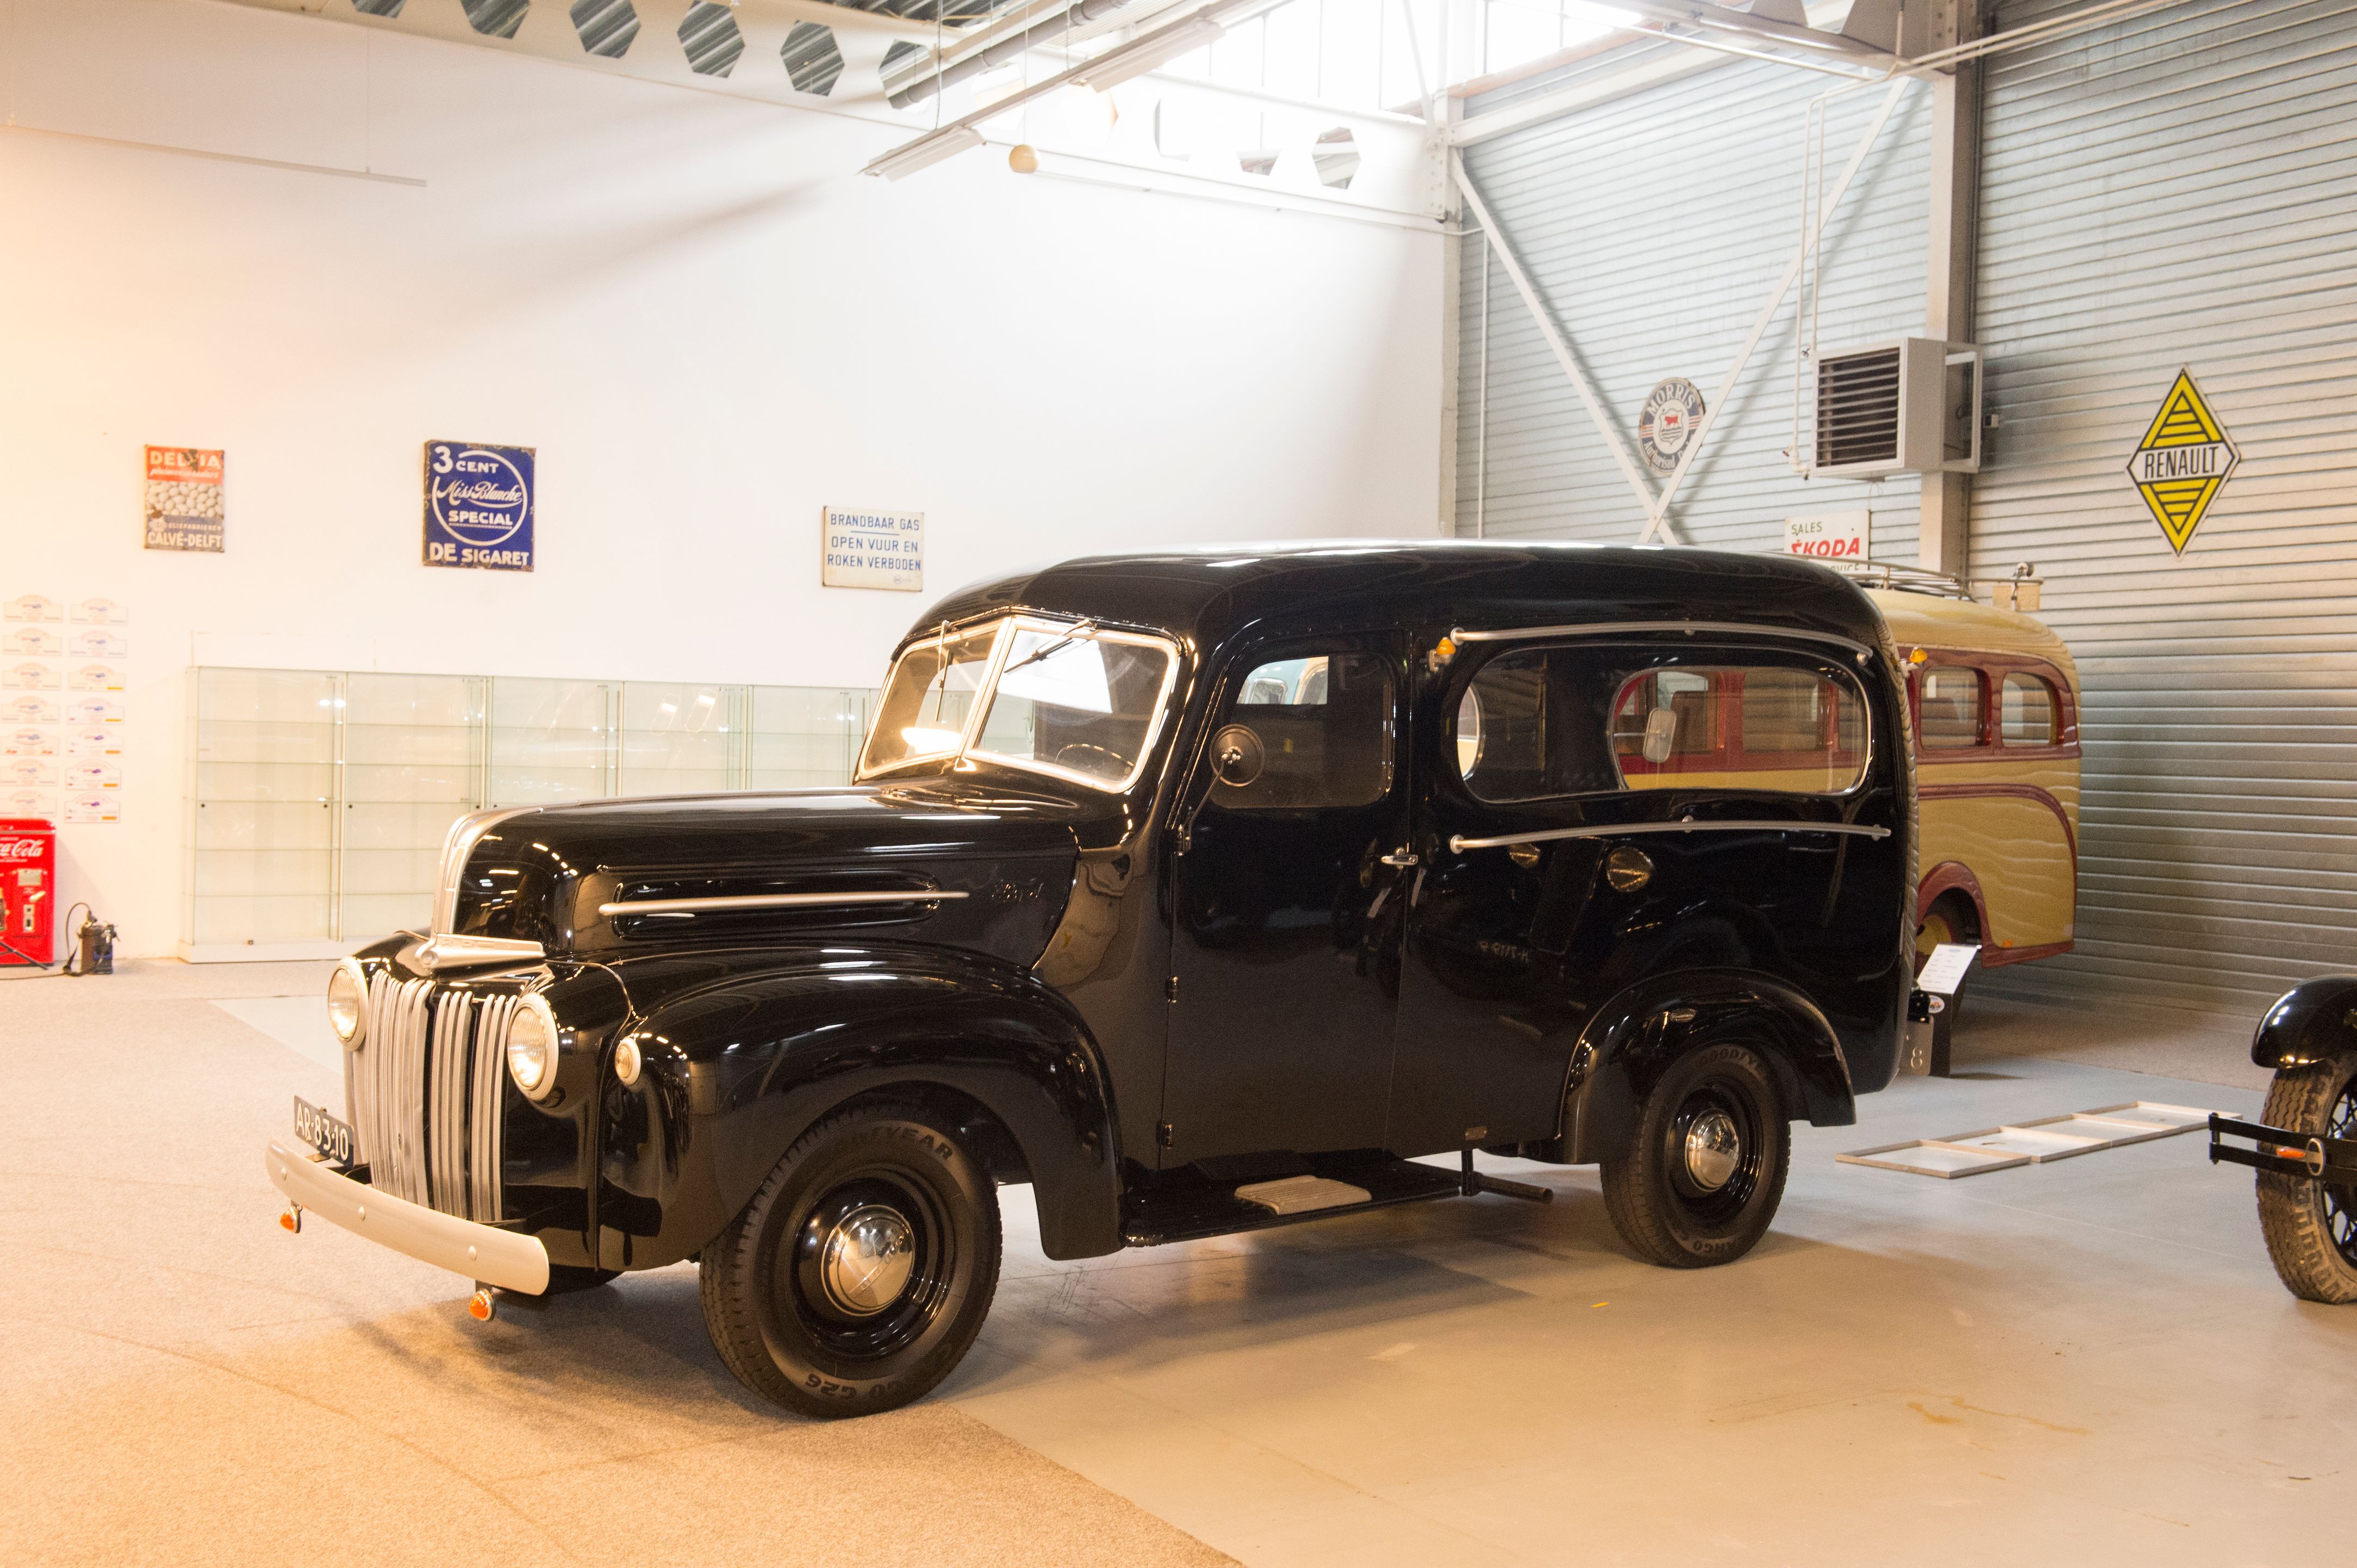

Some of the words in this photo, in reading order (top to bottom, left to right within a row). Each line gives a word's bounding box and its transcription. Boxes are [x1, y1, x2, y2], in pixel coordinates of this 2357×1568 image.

[1646, 383, 1696, 415] MORRIS
[150, 450, 222, 469] DELIA
[433, 445, 453, 474] 3
[456, 461, 499, 473] CENT
[2144, 446, 2219, 479] RENAULT
[436, 480, 473, 506] Miss
[471, 481, 523, 503] Blanche
[448, 510, 513, 525] SPECIAL
[831, 513, 894, 529] BRANDBAAR
[900, 518, 920, 531] GAS
[1791, 521, 1823, 535] SALES
[430, 542, 457, 562] DE
[461, 548, 529, 566] SIGARET
[832, 536, 863, 549] OPEN
[868, 538, 899, 552] VUUR
[904, 541, 918, 553] EN
[828, 554, 863, 567] ROKEN
[868, 556, 921, 571] VERBODEN
[296, 1102, 349, 1161] AR-83-10
